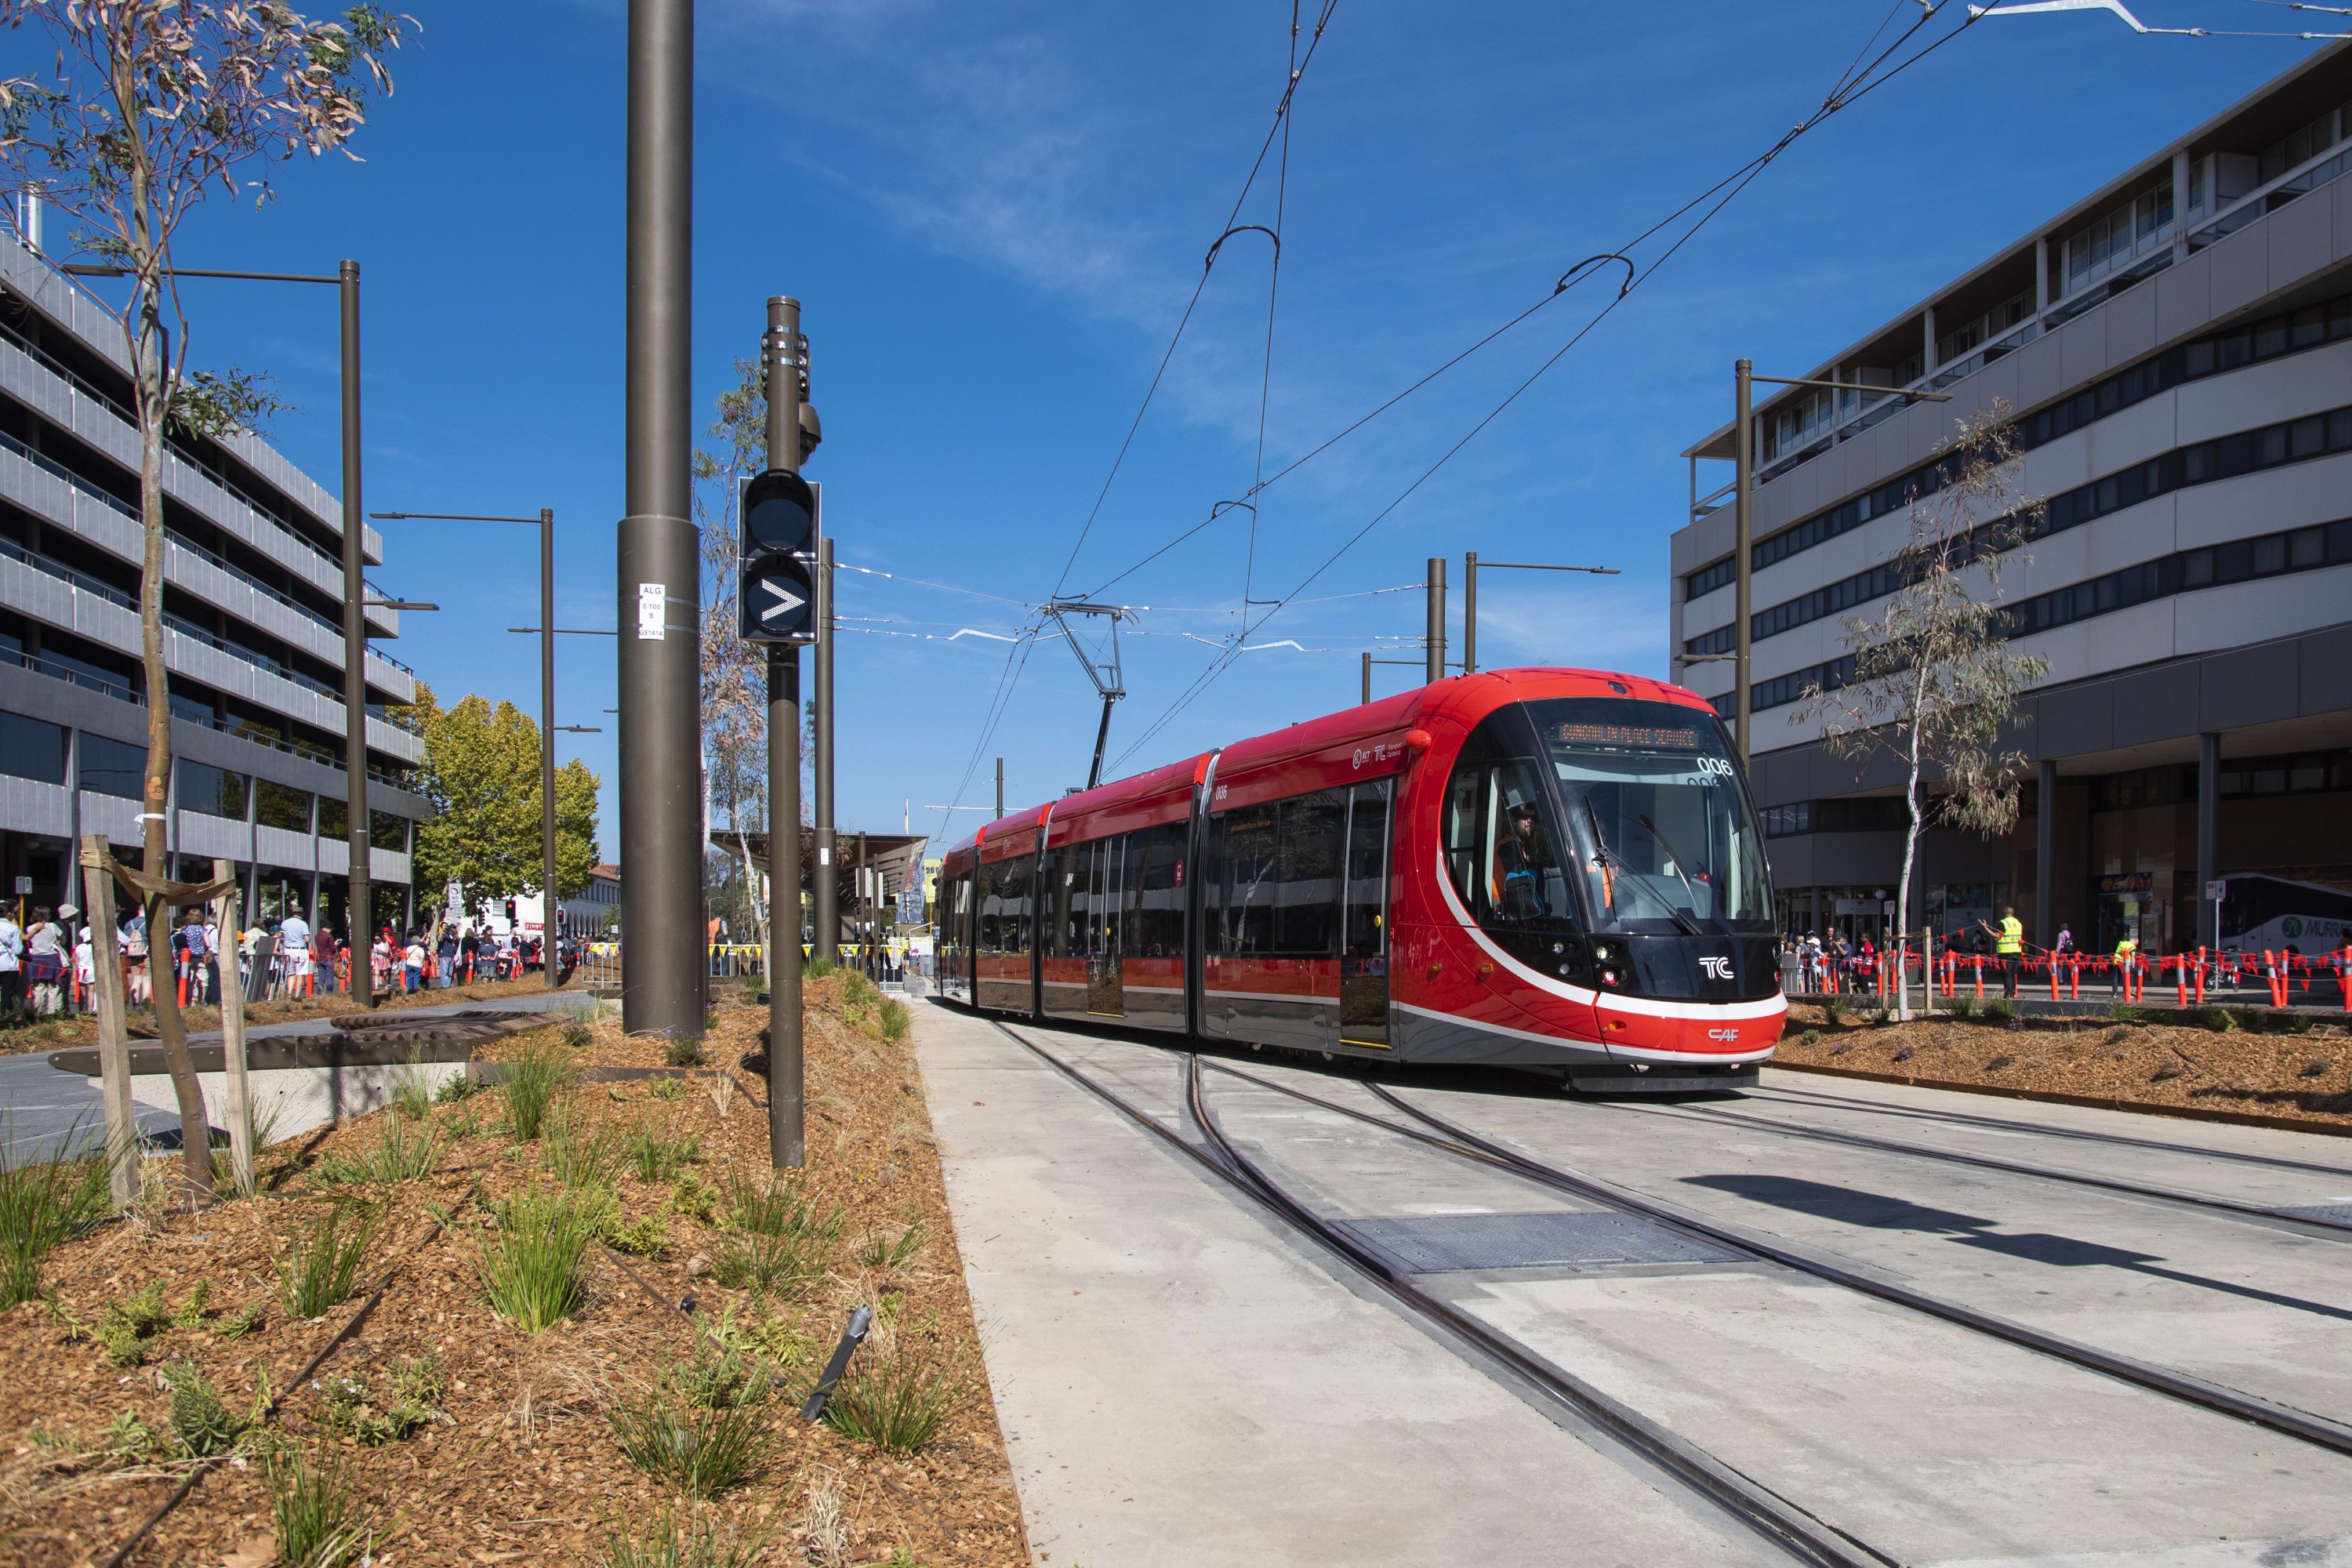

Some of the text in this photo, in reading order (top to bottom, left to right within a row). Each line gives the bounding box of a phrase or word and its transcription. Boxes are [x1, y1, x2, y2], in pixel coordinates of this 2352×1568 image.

[1621, 728, 1651, 744] PLACE
[1697, 757, 1733, 776] 006
[1216, 784, 1227, 800] 006
[2305, 920, 2352, 938] MURRA
[1698, 956, 1734, 979] TC
[1708, 1029, 1739, 1042] CAF
